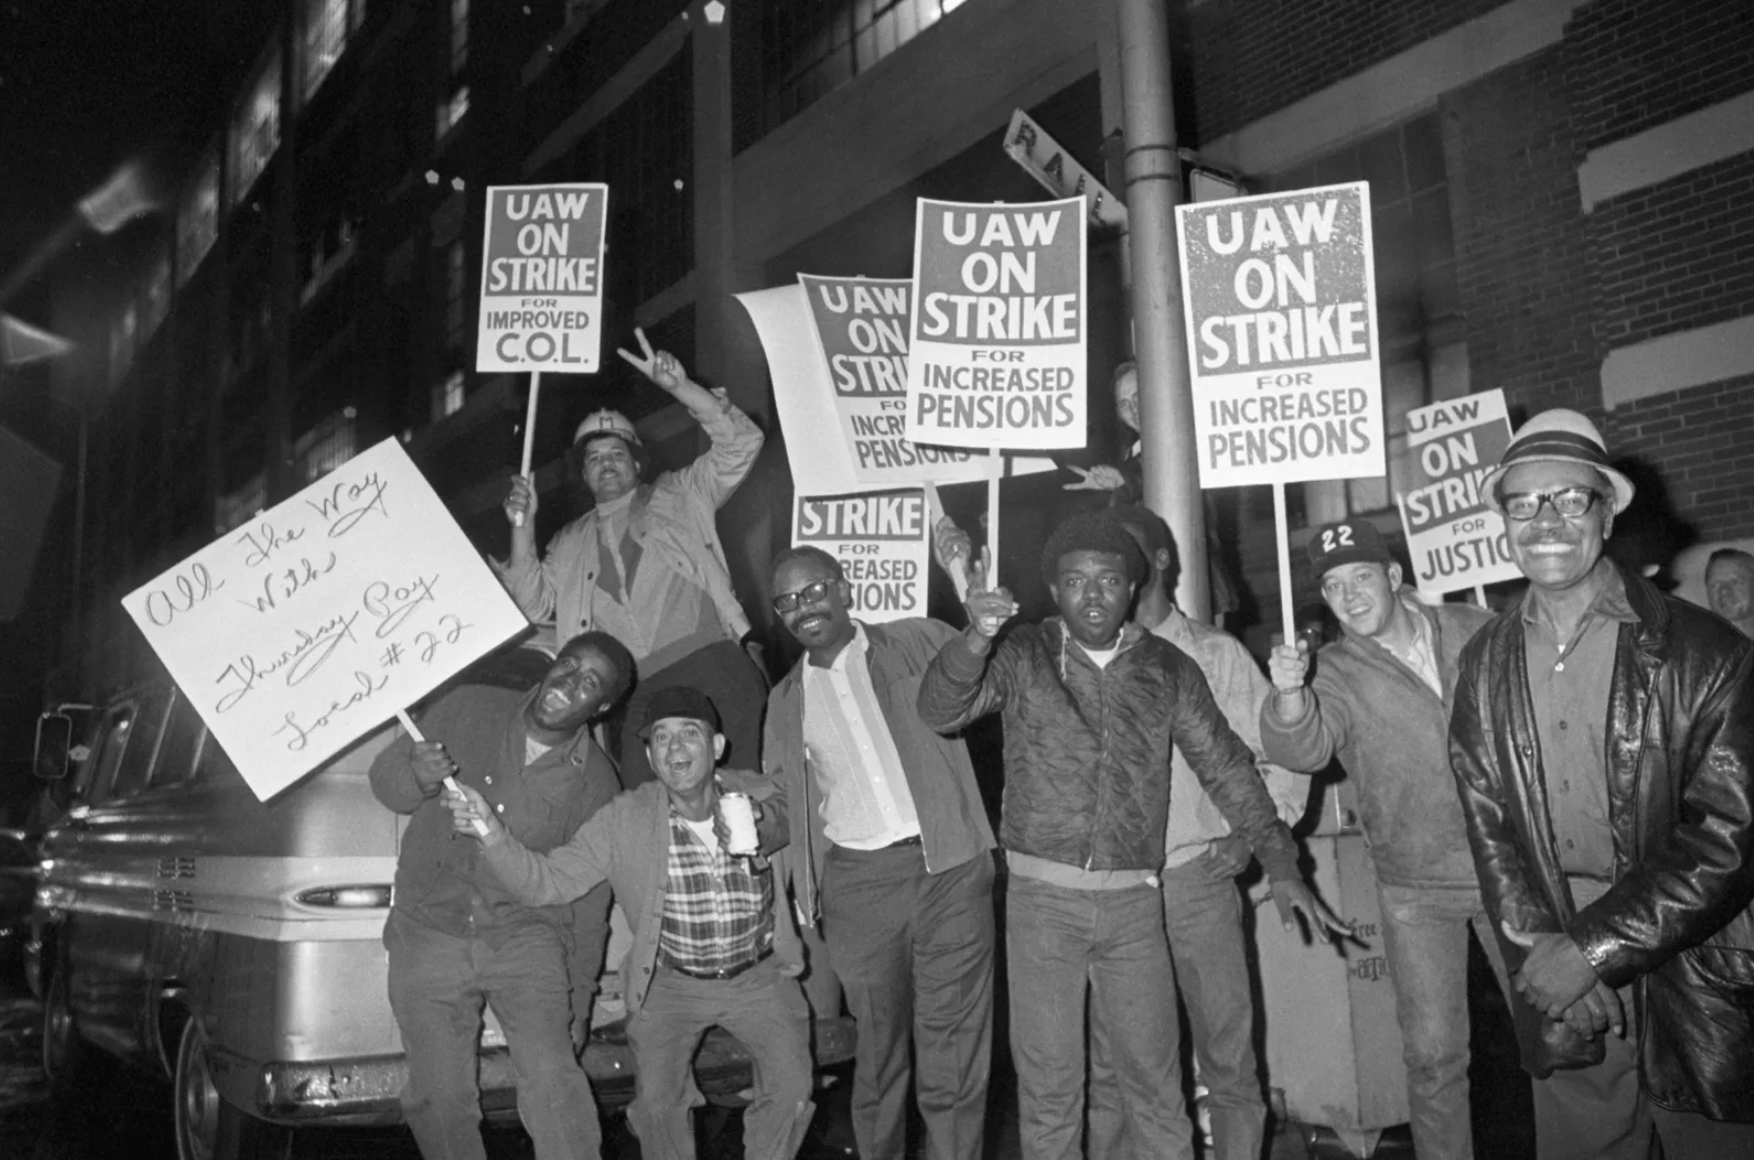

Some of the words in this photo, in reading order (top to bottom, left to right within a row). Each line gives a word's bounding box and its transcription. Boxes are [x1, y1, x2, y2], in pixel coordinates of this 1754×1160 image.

[506, 192, 589, 221] UAW
[517, 222, 569, 256] ON
[943, 210, 1062, 247] UAW
[1205, 198, 1338, 255] UAW
[489, 257, 596, 292] STRIKE
[961, 251, 1036, 294] ON
[1234, 250, 1317, 310] ON
[521, 298, 558, 308] FOR
[819, 284, 907, 315] UAW
[922, 291, 1077, 340] STRIKE
[487, 310, 590, 330] IMPROVED
[847, 318, 909, 354] ON
[1200, 301, 1368, 369] STRIKE
[496, 331, 590, 364] C.O.L.
[971, 350, 1025, 363] FOR
[831, 353, 909, 392] STRI
[923, 363, 1075, 392] INCREASED
[1256, 372, 1314, 390] FOR
[879, 400, 907, 411] FO
[916, 392, 1075, 429] PENSIONS
[1209, 387, 1369, 427] INCREASED
[1407, 400, 1480, 434] UAW
[850, 414, 906, 436] INCR
[1208, 416, 1371, 470] PENSIONS
[1421, 431, 1479, 478] ON
[306, 472, 389, 538] Way
[801, 496, 922, 536] STRIKE
[1321, 525, 1355, 553] 22
[1452, 518, 1486, 536] FOR
[838, 544, 880, 555] FOR
[1420, 533, 1513, 581] JUSTIC
[236, 551, 337, 613] With
[838, 559, 918, 581] REASED
[851, 582, 917, 612] IONS
[215, 610, 359, 714] Thursday
[363, 573, 440, 639] Pay
[270, 671, 389, 751] Local
